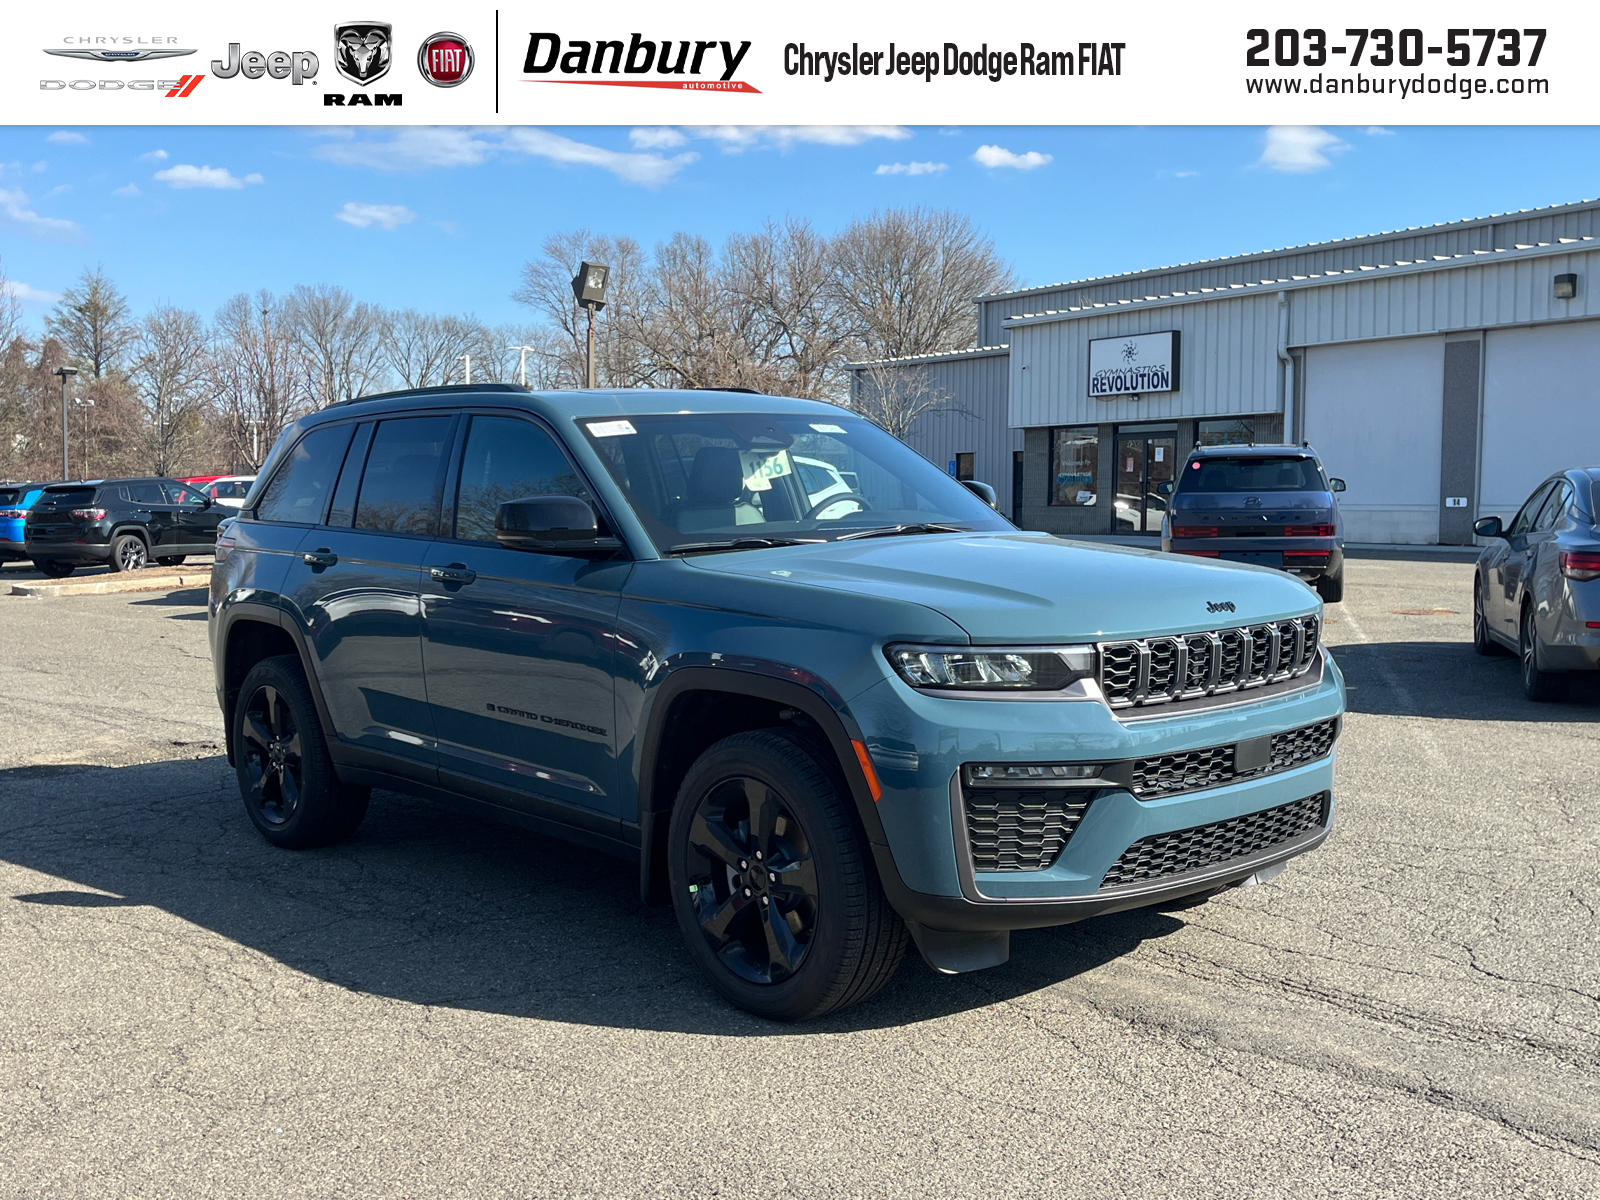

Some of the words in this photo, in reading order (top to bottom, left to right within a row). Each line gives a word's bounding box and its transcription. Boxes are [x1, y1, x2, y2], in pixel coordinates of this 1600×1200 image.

[1095, 364, 1166, 380] GYMNASTICS
[1092, 371, 1169, 394] REVOLUTION
[749, 457, 784, 480] 1156
[1453, 498, 1460, 506] 14
[1206, 600, 1236, 613] Jeep
